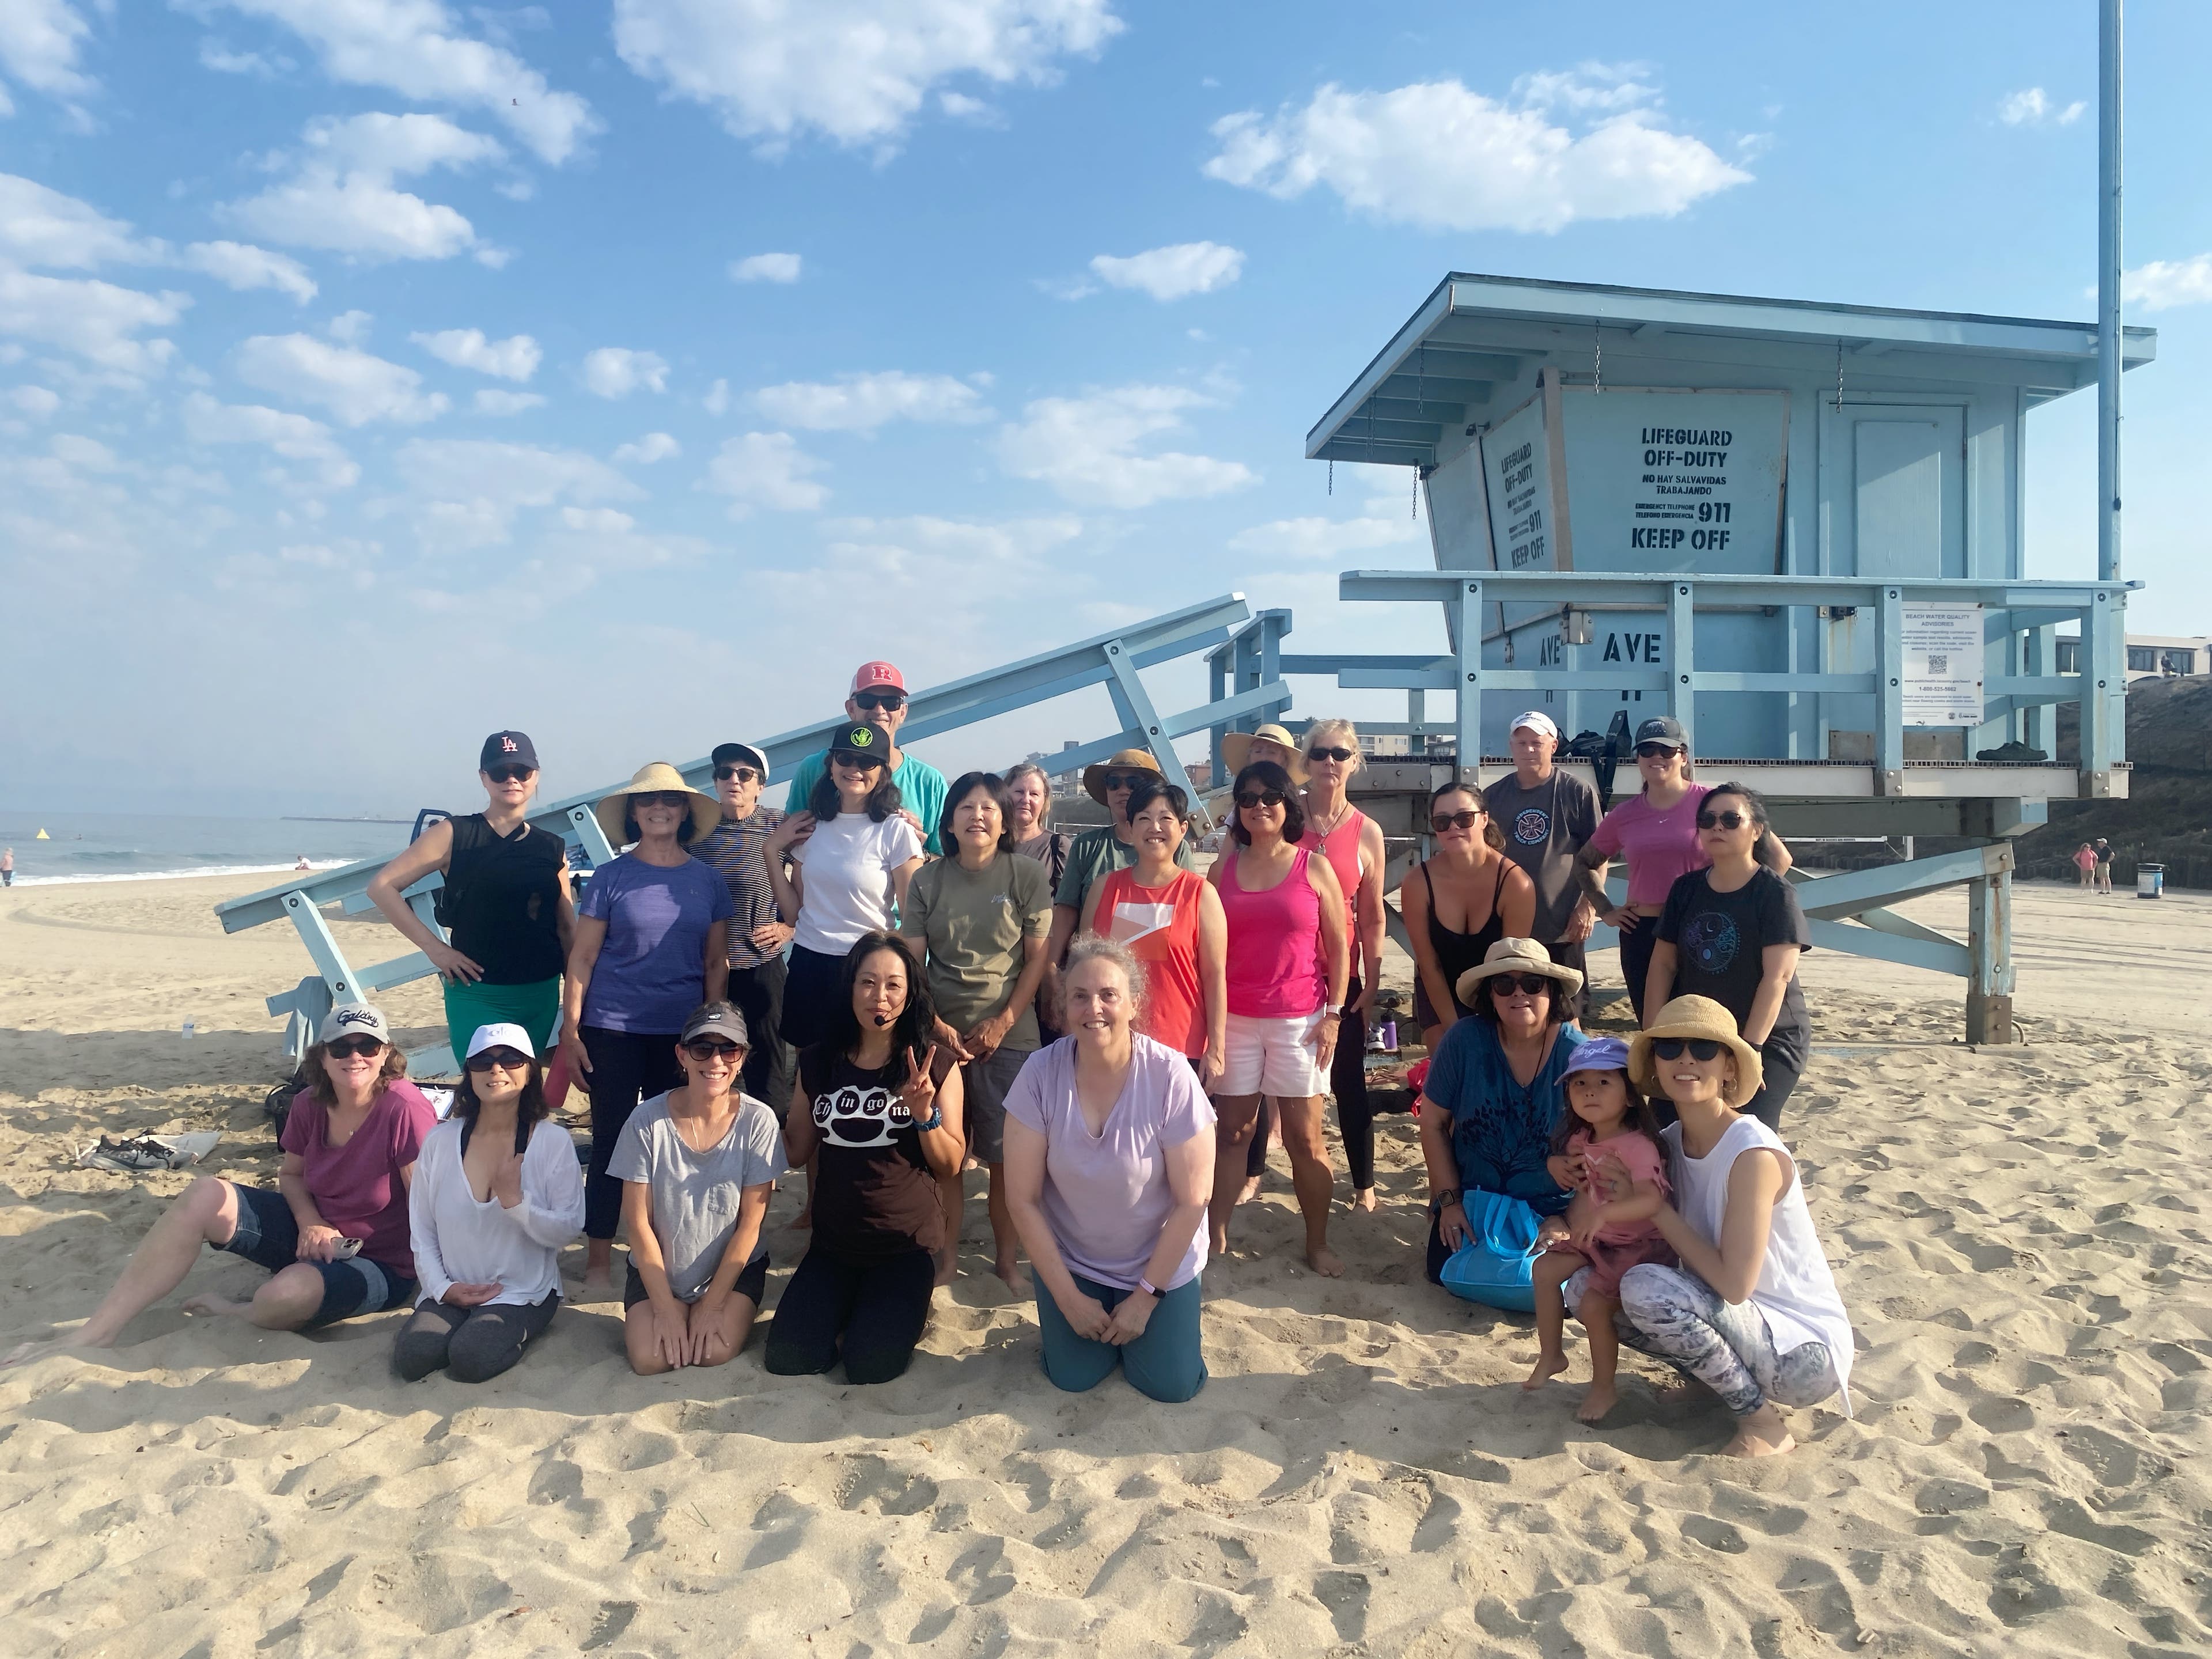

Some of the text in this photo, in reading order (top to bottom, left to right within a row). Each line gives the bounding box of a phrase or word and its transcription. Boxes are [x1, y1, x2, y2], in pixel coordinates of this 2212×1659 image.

[1642, 428, 1732, 446] LIFEGUARD
[1501, 442, 1532, 474] LIFEGUARD
[1645, 449, 1727, 467] OFF-DUTY
[1505, 463, 1532, 493] OFF-DUTY
[1642, 475, 1726, 485] NO HAY SALVAVIDAS
[1657, 486, 1712, 495] TRABAJANDO
[1529, 510, 1541, 533] 911
[1699, 502, 1730, 522] 911
[1631, 528, 1730, 550] KEEP OFF
[1511, 536, 1544, 569] KEEP OFF
[1540, 634, 1560, 666] AVE
[1603, 632, 1661, 663] AVE
[872, 664, 893, 682] R
[501, 736, 518, 752] LA
[337, 1009, 378, 1028] Galaxy
[1569, 1042, 1611, 1060] Angel
